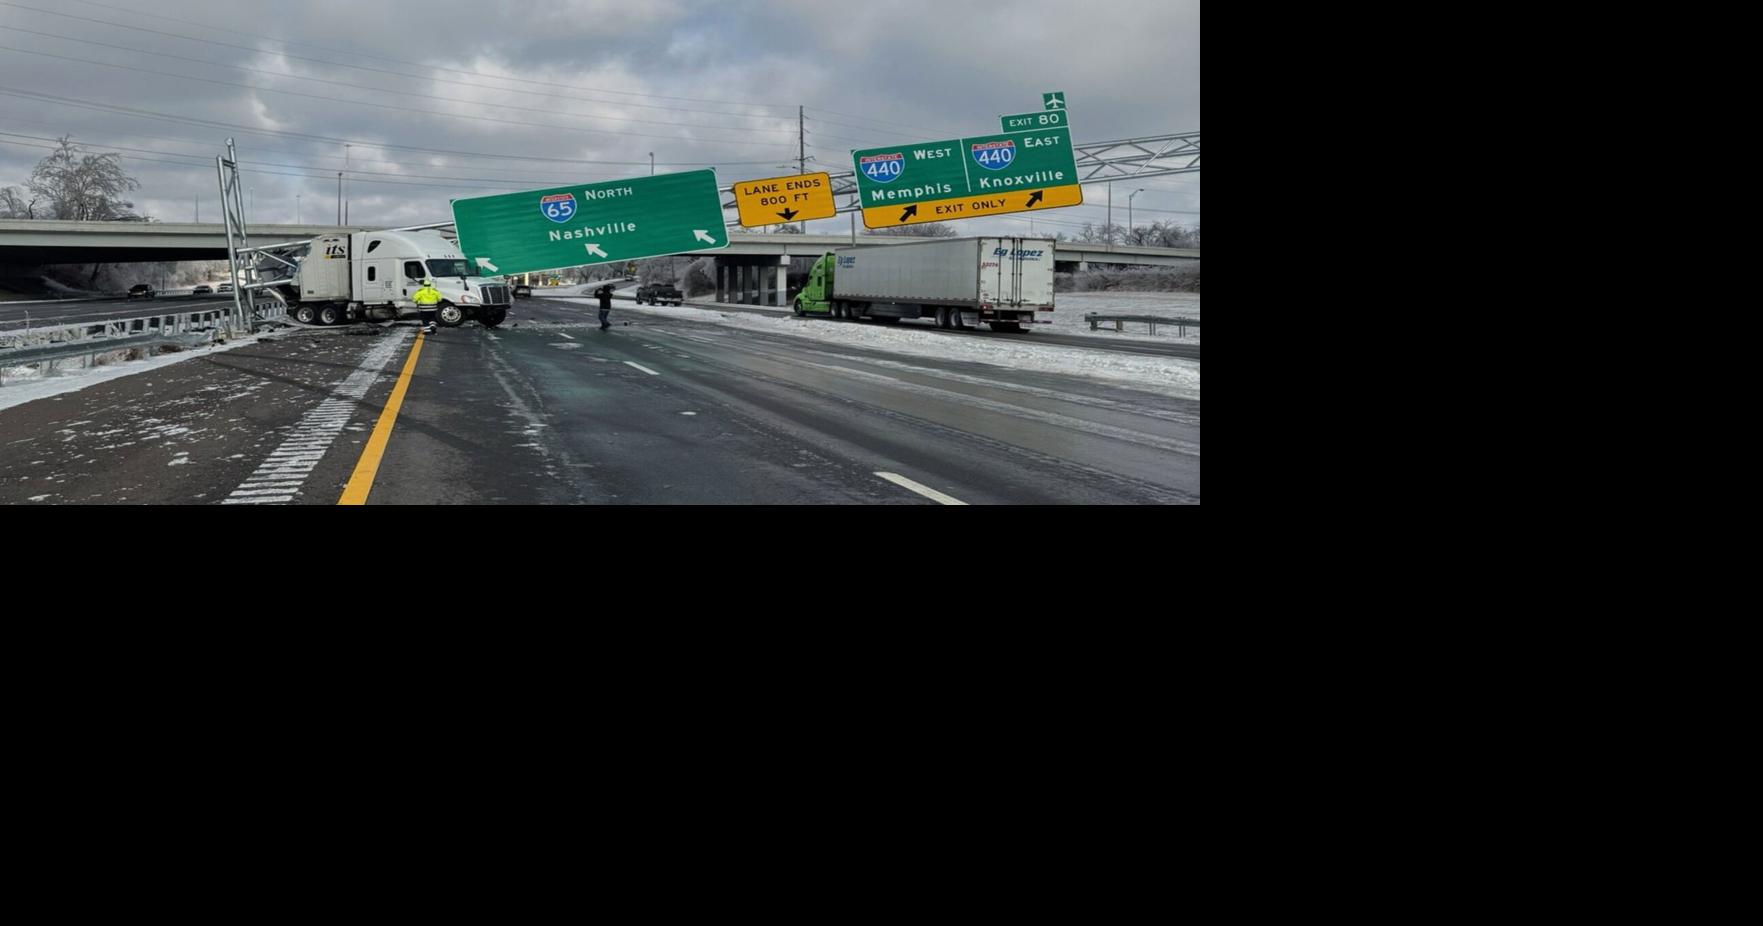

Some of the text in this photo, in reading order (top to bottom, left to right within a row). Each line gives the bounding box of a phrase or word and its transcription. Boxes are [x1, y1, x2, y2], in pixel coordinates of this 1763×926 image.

[1009, 113, 1060, 127] EXIT 80
[1024, 136, 1060, 148] EAST
[913, 148, 952, 160] WEST
[979, 148, 1012, 165] 440
[867, 161, 900, 177] 440
[980, 170, 1064, 189] Knoxville
[584, 187, 633, 200] NORTH
[744, 179, 821, 196] LANE ENDS
[871, 183, 952, 201] Memphis
[760, 192, 809, 206] 800 FT
[935, 199, 1006, 214] EXIT ONLY
[547, 201, 572, 218] 65
[549, 222, 636, 242] Nashville
[325, 244, 346, 255] its
[1010, 248, 1044, 257] Lopez
